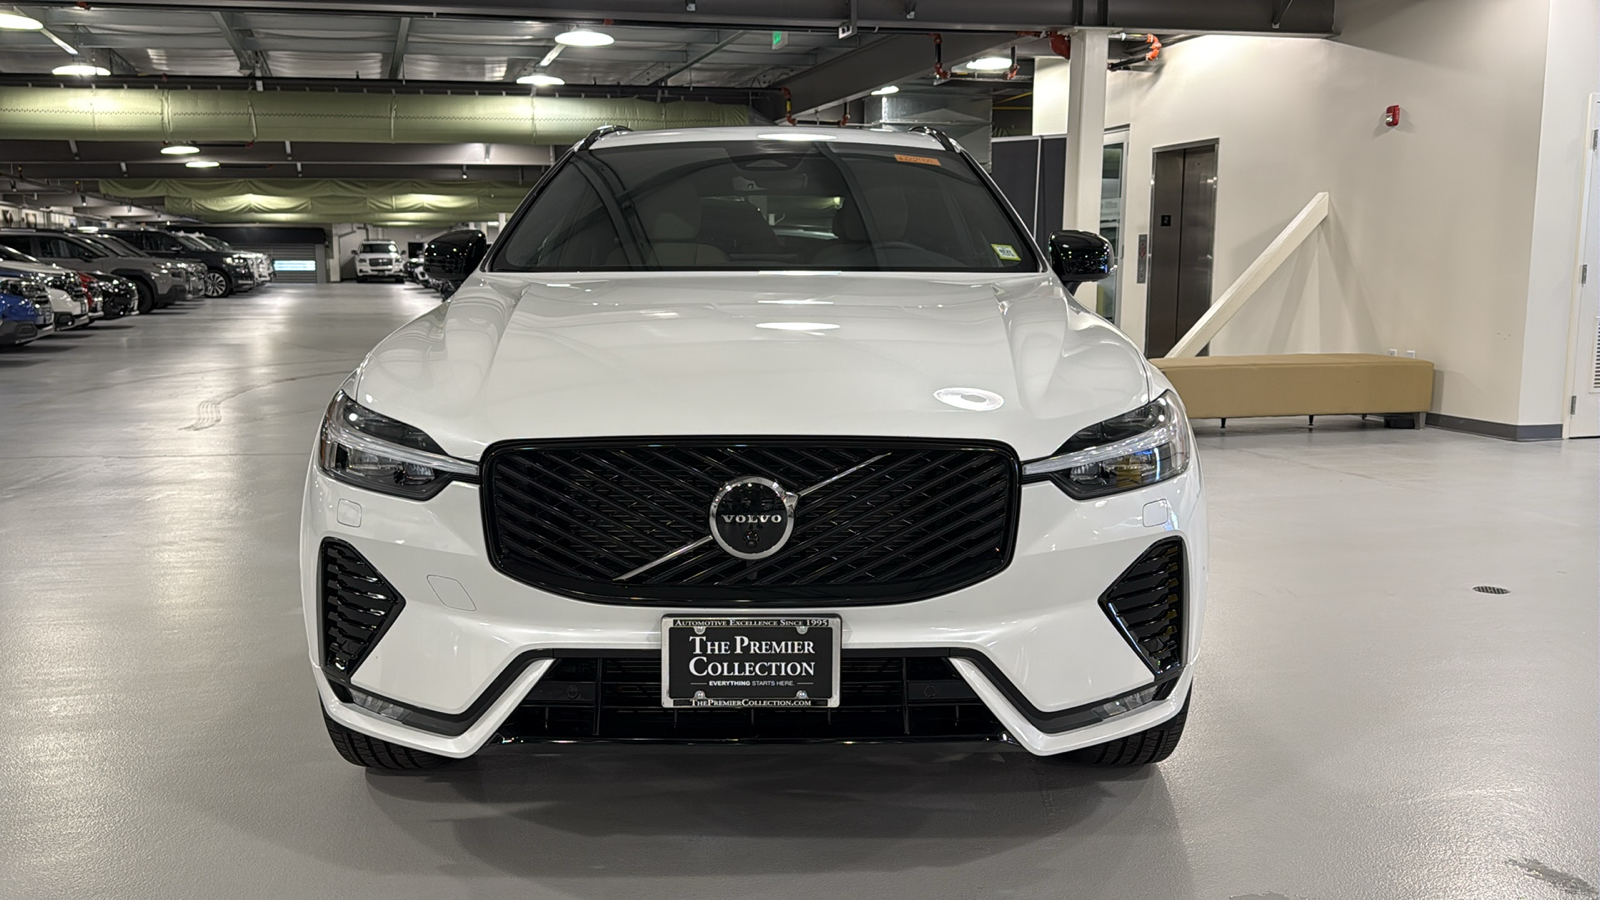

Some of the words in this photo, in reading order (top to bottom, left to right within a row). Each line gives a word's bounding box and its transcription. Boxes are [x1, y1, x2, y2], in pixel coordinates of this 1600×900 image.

[721, 514, 782, 523] VOLVO
[806, 619, 828, 627] 1995
[688, 635, 731, 655] THE
[733, 635, 816, 655] PREMIER
[688, 656, 816, 676] COLLECTION
